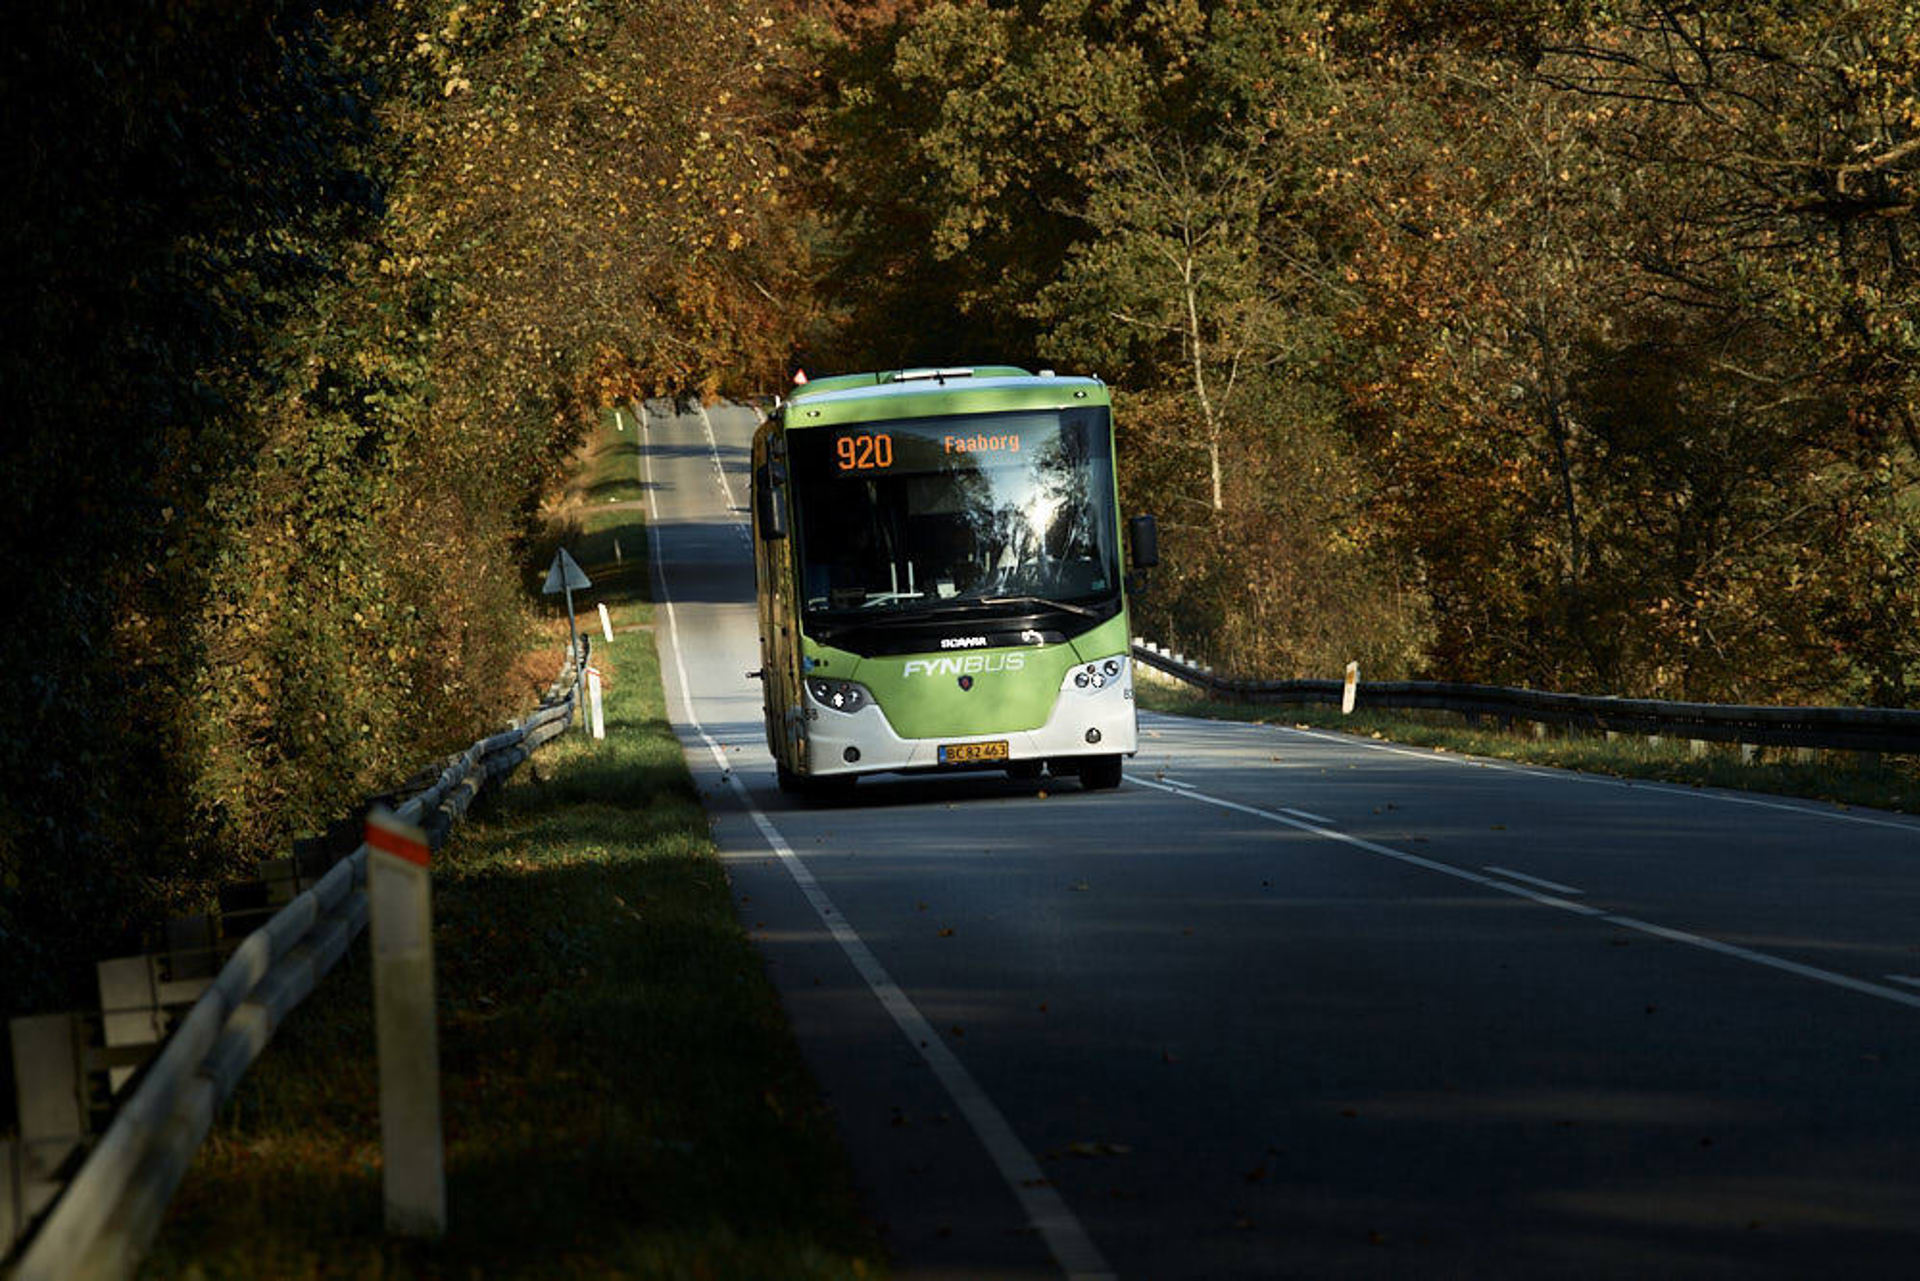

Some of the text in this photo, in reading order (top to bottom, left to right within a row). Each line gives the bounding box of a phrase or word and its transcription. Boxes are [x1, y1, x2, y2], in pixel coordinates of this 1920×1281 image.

[837, 433, 1019, 469] 920 Faaborg
[903, 652, 1026, 677] FYNBUS
